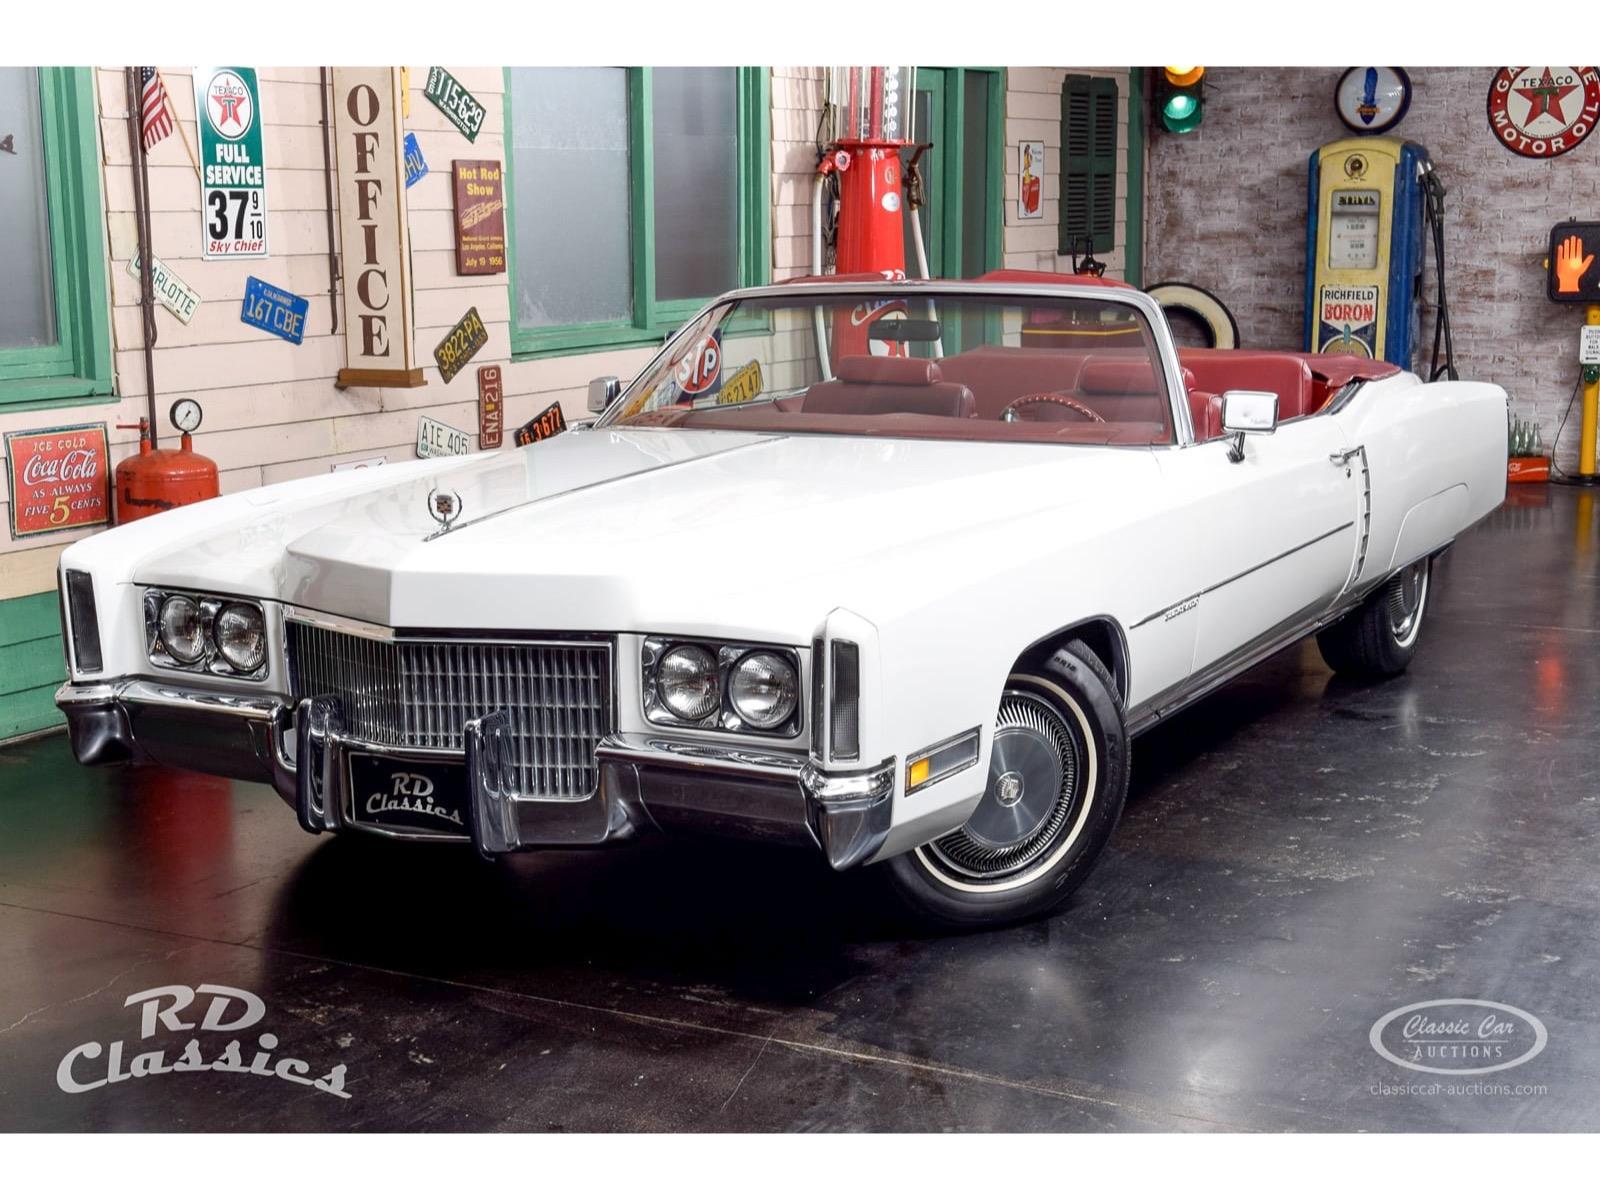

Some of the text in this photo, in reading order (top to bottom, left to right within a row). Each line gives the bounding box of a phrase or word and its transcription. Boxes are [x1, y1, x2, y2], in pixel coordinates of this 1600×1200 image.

[1521, 75, 1573, 88] TEXACO
[1572, 102, 1600, 137] OIL
[1494, 110, 1565, 154] MOTOR
[215, 143, 250, 164] FULL
[206, 164, 263, 185] SERVICE
[459, 167, 500, 181] Hot Rod
[466, 183, 494, 196] Show
[208, 190, 249, 241] 37
[347, 83, 390, 357] OFFICE
[209, 240, 263, 254] Sky Chief
[1324, 289, 1374, 301] RICHFIELD
[246, 293, 304, 337] 167 CBE
[1323, 303, 1374, 321] BORON
[678, 341, 718, 386] STP
[484, 369, 499, 444] ENA 216
[33, 438, 87, 453] ICE COLD
[447, 432, 469, 456] 405
[32, 481, 93, 499] AS ALWAYS
[25, 495, 101, 524] FIVE 5 CENTS
[391, 772, 434, 797] RD
[366, 793, 464, 826] Classics
